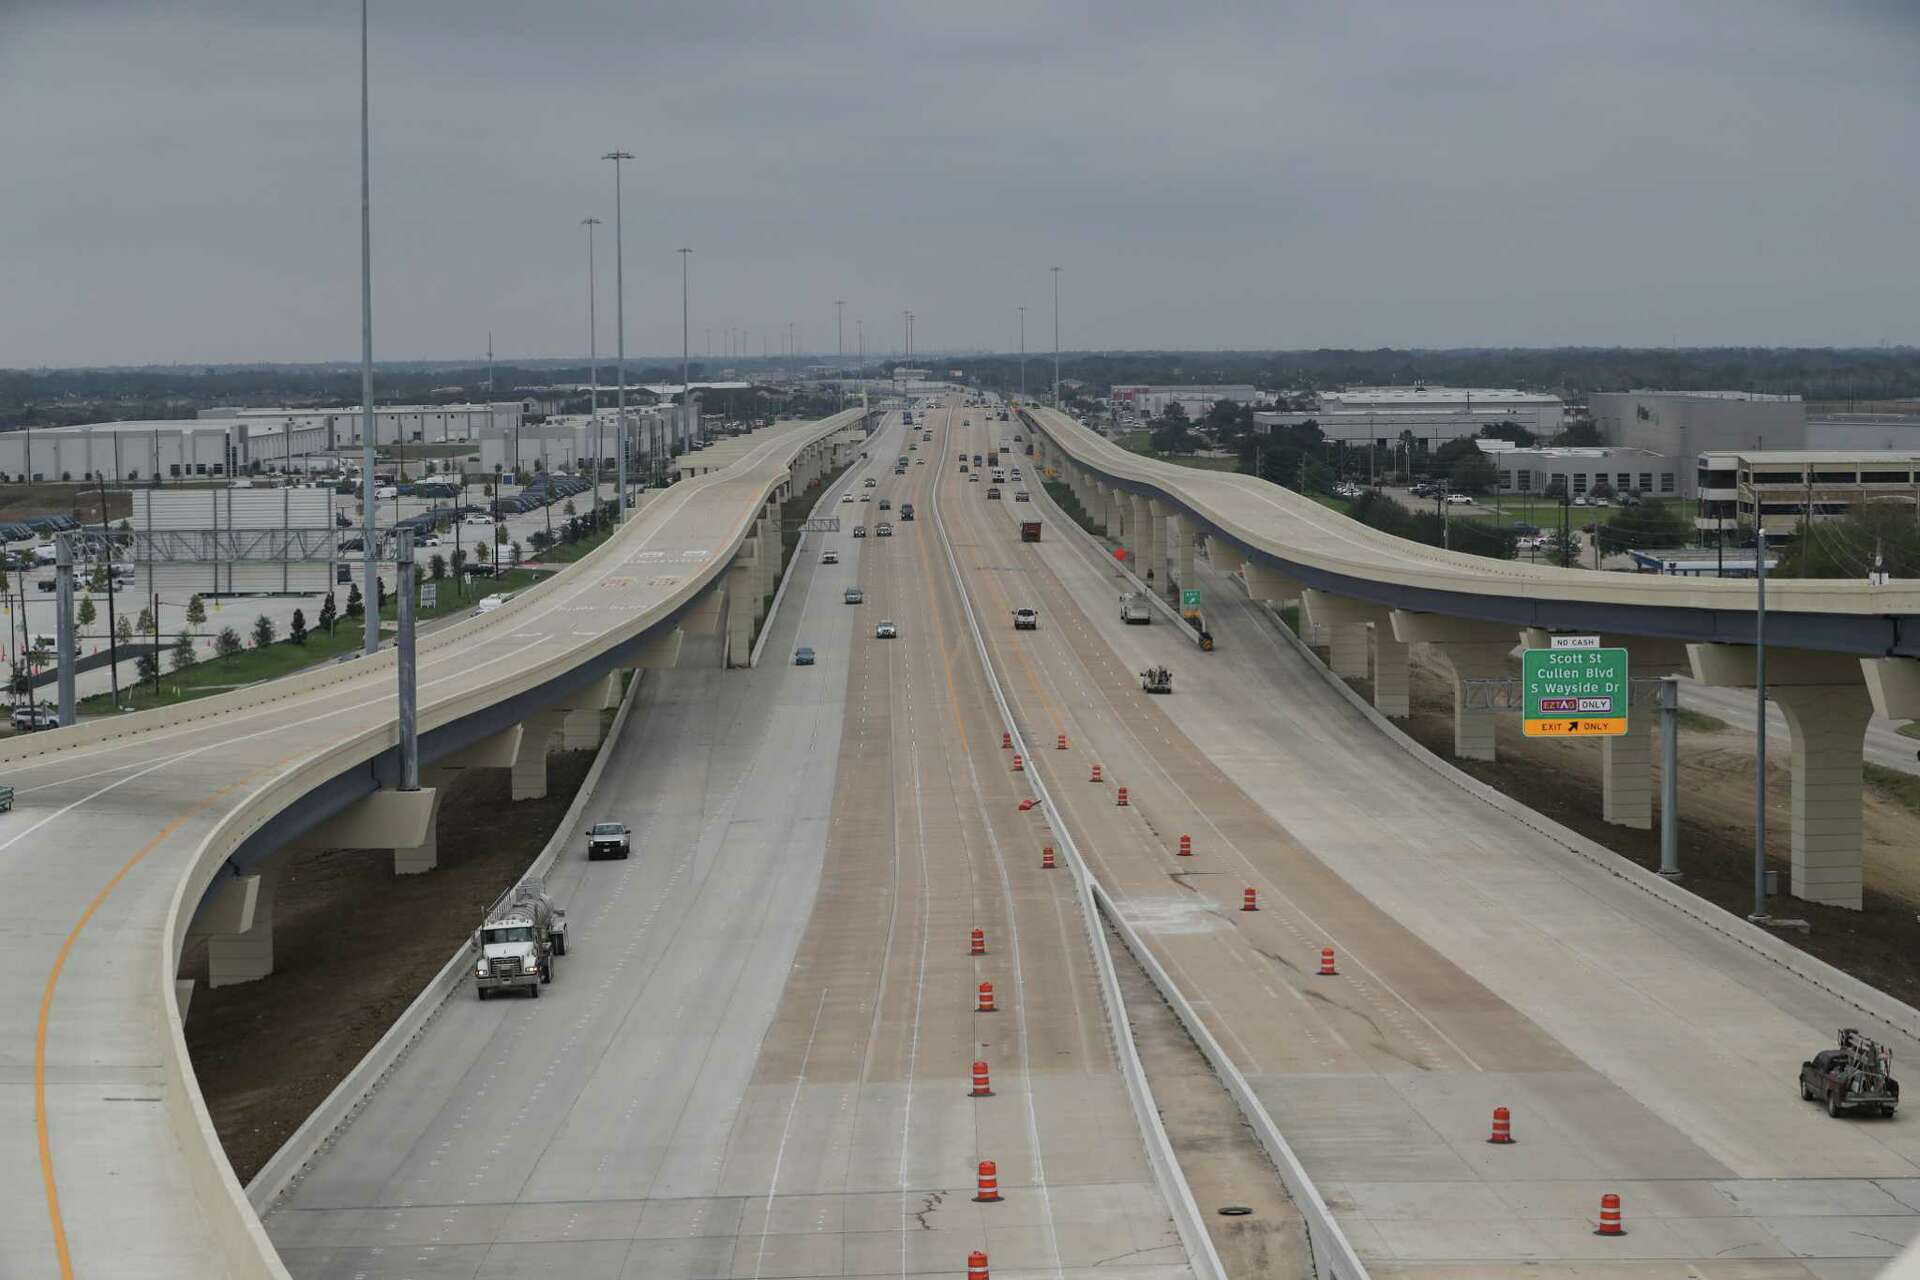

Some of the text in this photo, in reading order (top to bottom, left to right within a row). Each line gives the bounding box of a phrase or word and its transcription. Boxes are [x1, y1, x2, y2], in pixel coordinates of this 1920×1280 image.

[1549, 653, 1602, 664] Scott St
[1537, 668, 1614, 679] Cullen Blvd
[1531, 683, 1620, 695] S Wayside Dr
[1541, 723, 1562, 731] EXIT
